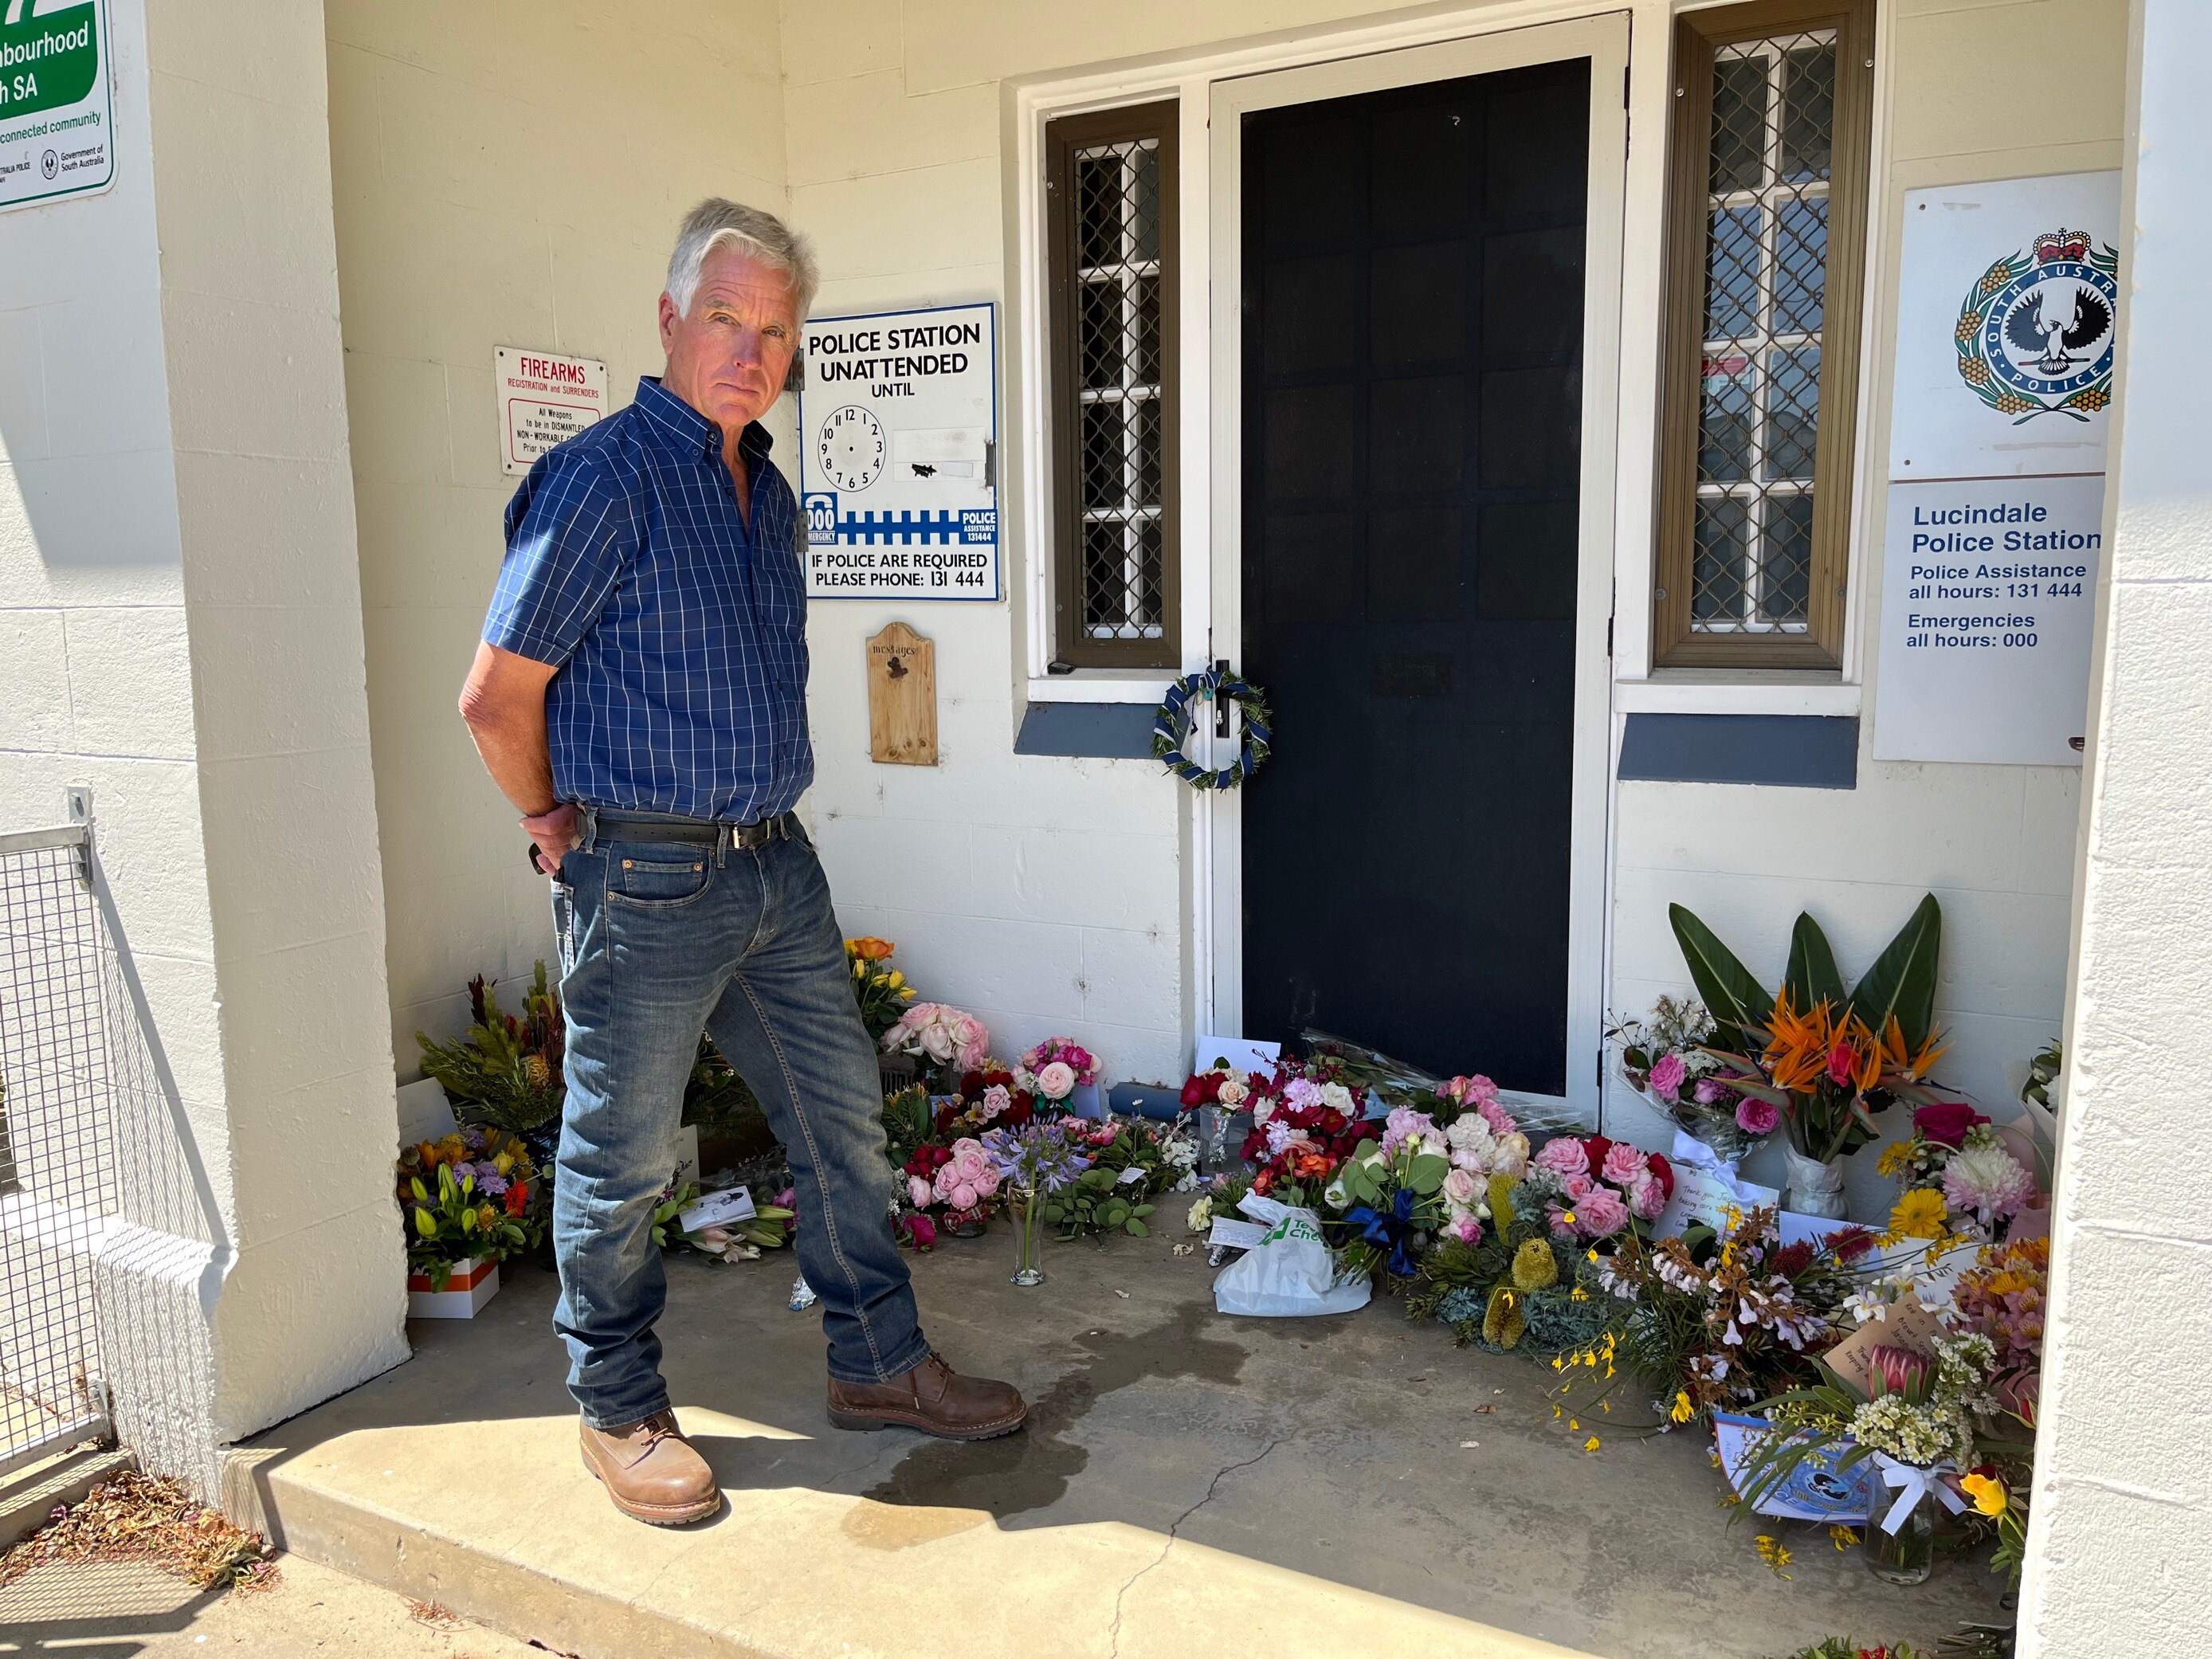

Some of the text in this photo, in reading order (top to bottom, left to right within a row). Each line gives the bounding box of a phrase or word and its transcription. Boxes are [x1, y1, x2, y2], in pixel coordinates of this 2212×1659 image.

[0, 21, 88, 67] bourhood
[14, 73, 38, 100] SA
[0, 111, 101, 143] connected community
[61, 144, 104, 161] Government of
[61, 161, 78, 172] South
[79, 156, 104, 169] Australia
[1987, 284, 2022, 358] SOUTH
[809, 323, 981, 356] POLICE STATION
[520, 357, 586, 385] FIREARMS
[821, 353, 969, 382] UNATTENDED
[2010, 366, 2101, 392] POLICE
[508, 378, 548, 391] REGISTRATION
[563, 386, 599, 398] SURRENDERS
[871, 382, 916, 398] UNTIL
[548, 409, 573, 421] Weapons
[834, 414, 841, 426] 11
[845, 409, 856, 421] 12
[863, 413, 867, 425] 1
[535, 419, 542, 428] be
[544, 421, 550, 429] in
[551, 422, 586, 433] DISMANTLED
[871, 424, 878, 436] 2
[823, 428, 833, 440] 10
[523, 443, 537, 453] Prior
[821, 443, 828, 455] 9
[876, 441, 883, 453] 3
[826, 458, 833, 470] 8
[873, 457, 880, 469] 4
[836, 473, 842, 484] 7
[849, 477, 856, 488] 6
[862, 473, 869, 484] 5
[807, 509, 835, 531] 000
[963, 512, 996, 525] POLICE
[1913, 503, 2048, 526] Lucindale
[808, 532, 835, 542] MERGENCY
[967, 532, 992, 542] 131444
[1912, 529, 2101, 553] Police Station
[811, 554, 988, 570] IF POLICE ARE REQUIRED
[1911, 563, 2087, 579] Police Assistance
[815, 571, 984, 586] PLEASE PHONE: 131 444
[1908, 582, 2083, 599] all hours: 131 444
[1908, 614, 2035, 631] Emergencies
[1906, 633, 2038, 648] all hours: 000
[873, 645, 916, 657] messages
[1683, 1186, 1700, 1195] Thank
[1905, 1303, 1916, 1315] Rest
